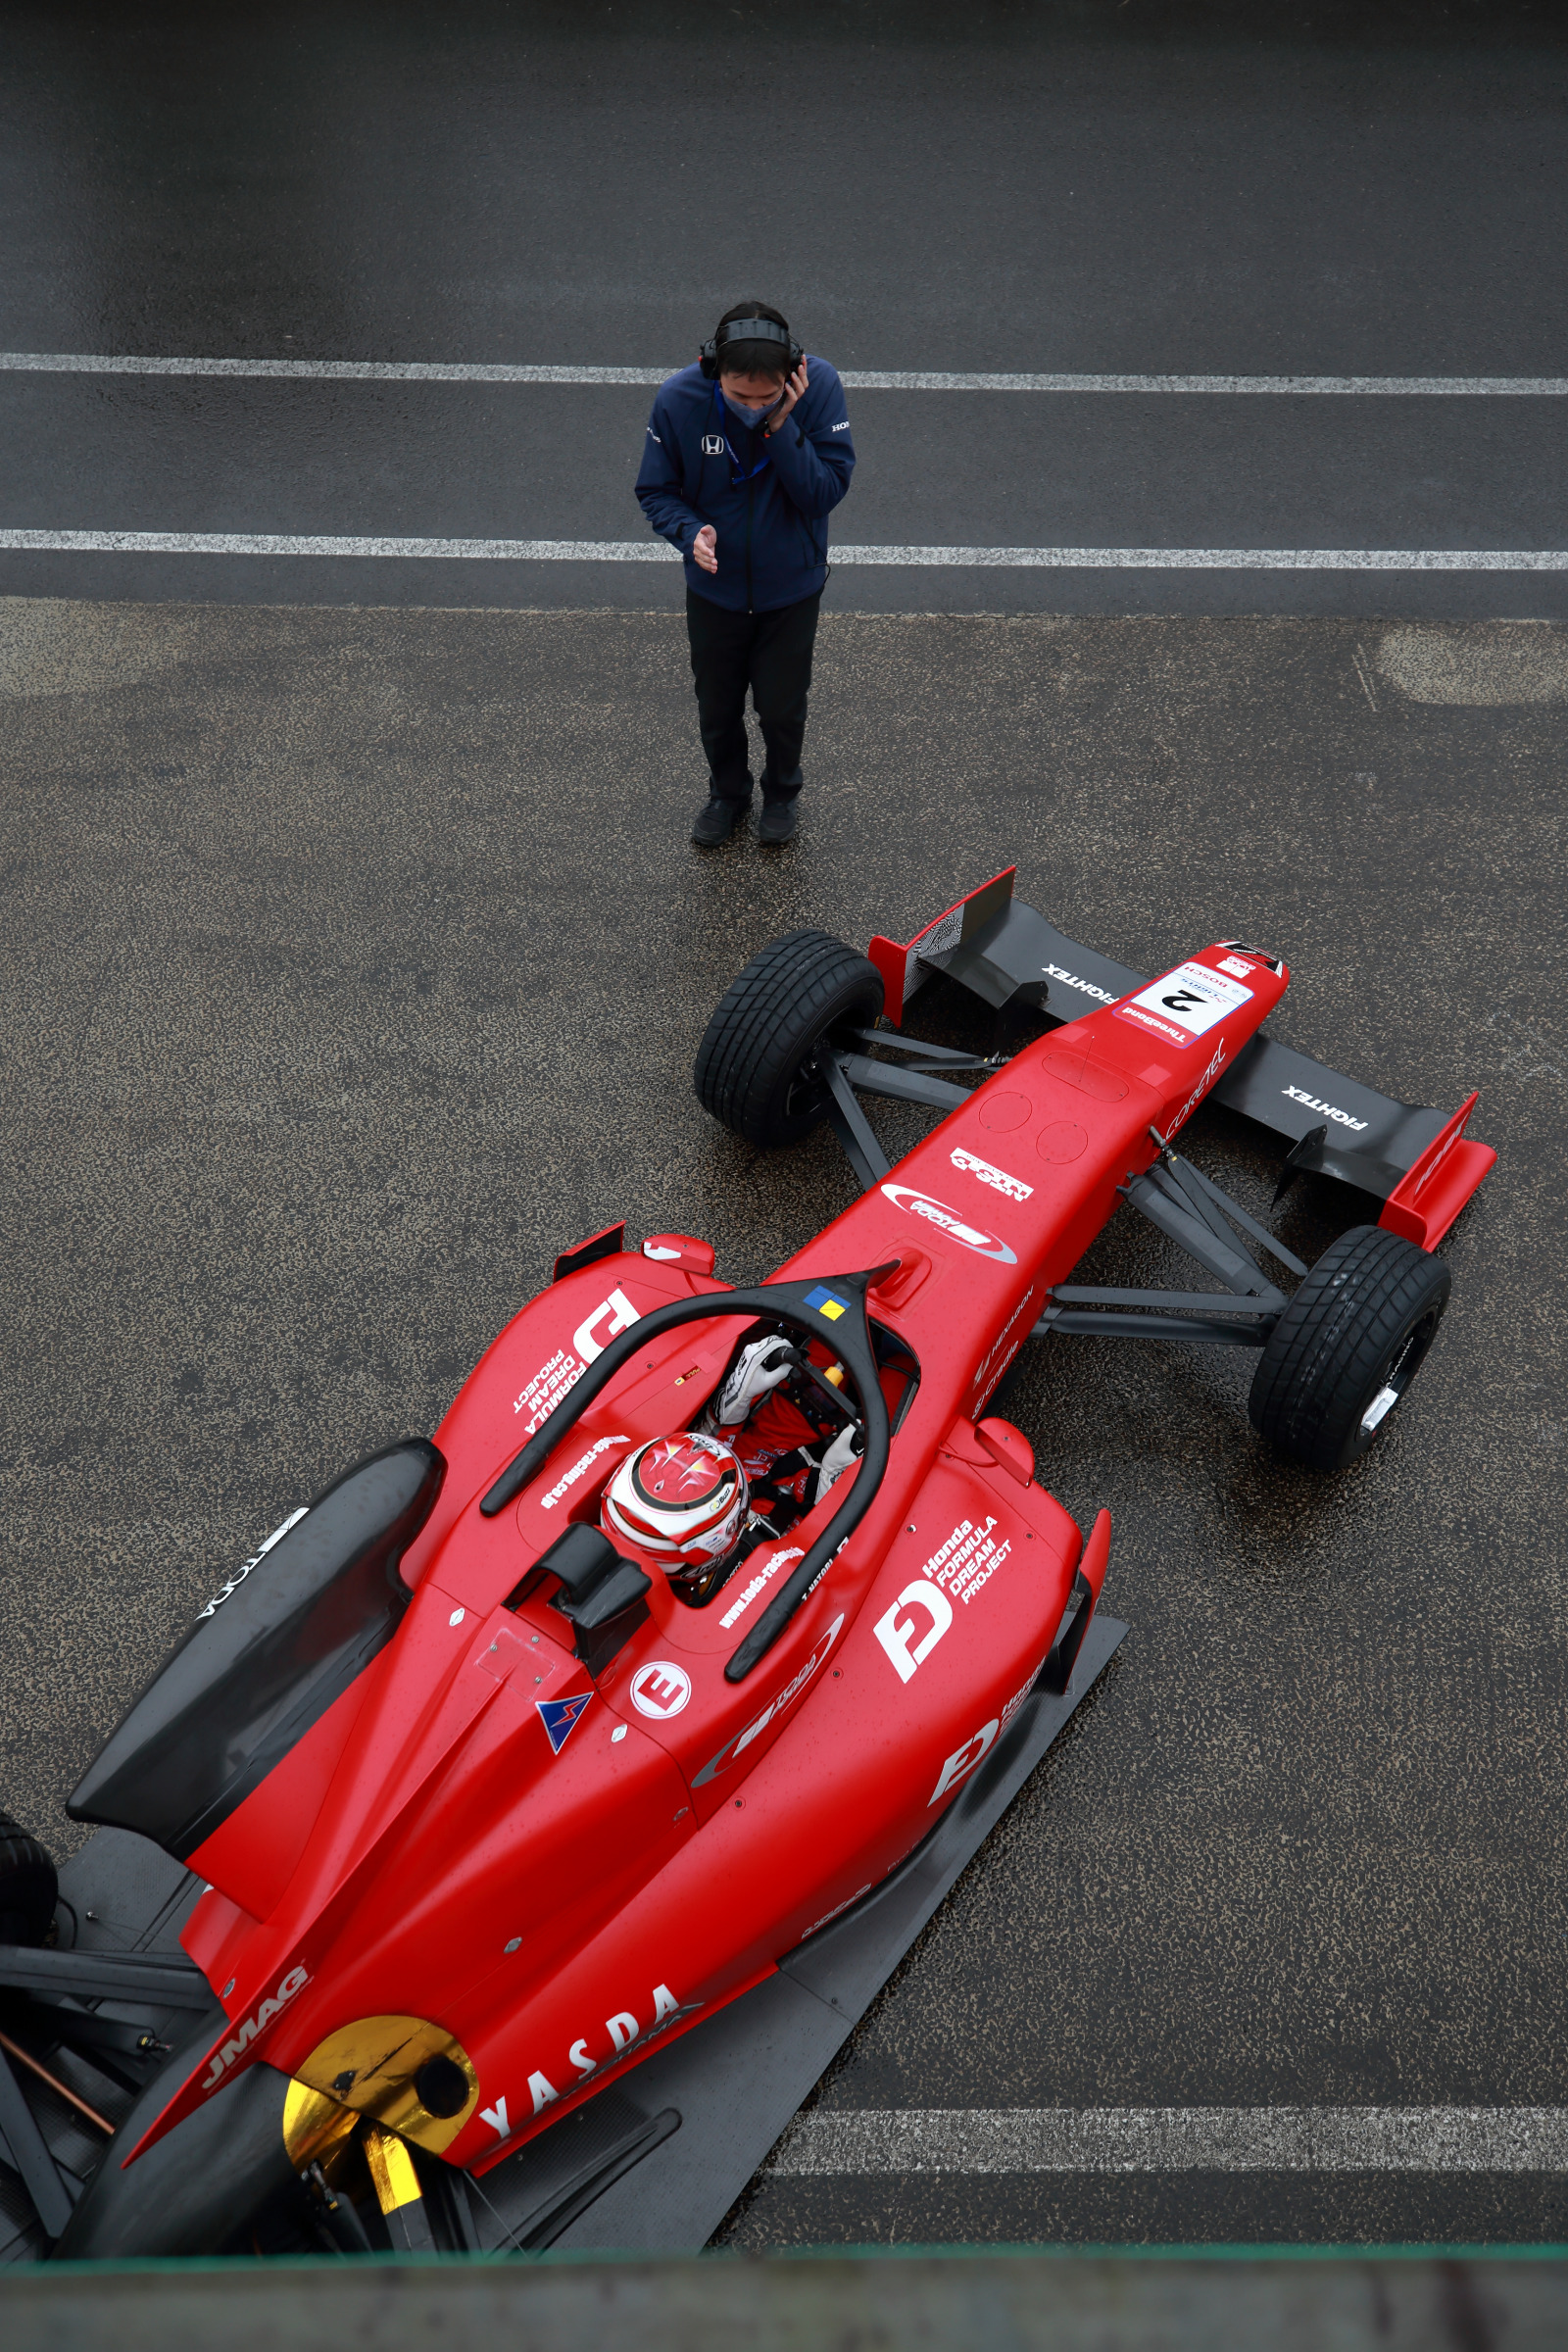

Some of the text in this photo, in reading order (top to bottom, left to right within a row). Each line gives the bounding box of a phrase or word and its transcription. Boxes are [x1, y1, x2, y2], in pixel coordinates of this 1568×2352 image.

[1041, 962, 1120, 1005] FIGHTEX
[1161, 989, 1209, 1012] 2
[1184, 966, 1228, 988] BOSCH
[1122, 1005, 1187, 1044] ThreeBond
[1281, 1084, 1369, 1132] FIGHTEX
[991, 1285, 1034, 1357] HEXAGON
[513, 1348, 565, 1414] PROJECT
[523, 1360, 588, 1435] FORMULA
[527, 1354, 576, 1412] DREAM
[540, 1434, 632, 1509] da-racing.co.jp
[921, 1519, 974, 1580] Honda
[936, 1515, 998, 1589] FORMULA
[949, 1537, 997, 1597] DREAM
[960, 1539, 1012, 1605] PROJECT
[201, 1965, 310, 2090] JMAG
[478, 1983, 680, 2140] YASDA
